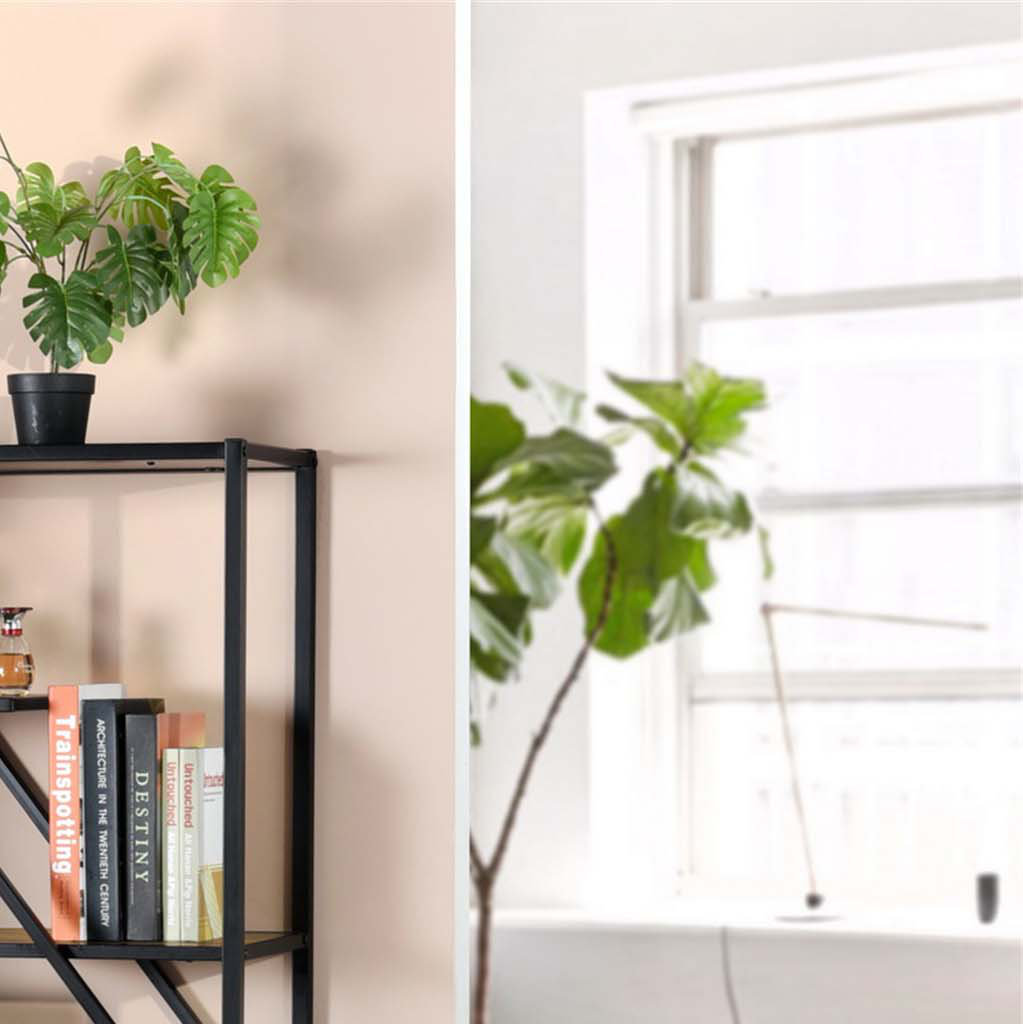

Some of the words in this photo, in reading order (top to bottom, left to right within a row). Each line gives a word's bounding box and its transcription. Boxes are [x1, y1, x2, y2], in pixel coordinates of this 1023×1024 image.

[96, 718, 107, 789] ARCHITECTURE
[52, 715, 77, 874] Trainspotting
[98, 793, 106, 805] IN
[98, 808, 108, 825] THE
[166, 761, 177, 826] Untouched
[184, 762, 194, 828] Untouched
[98, 830, 109, 880] TWENTIETH
[135, 771, 149, 883] DESTINY
[99, 883, 109, 928] CENTURY
